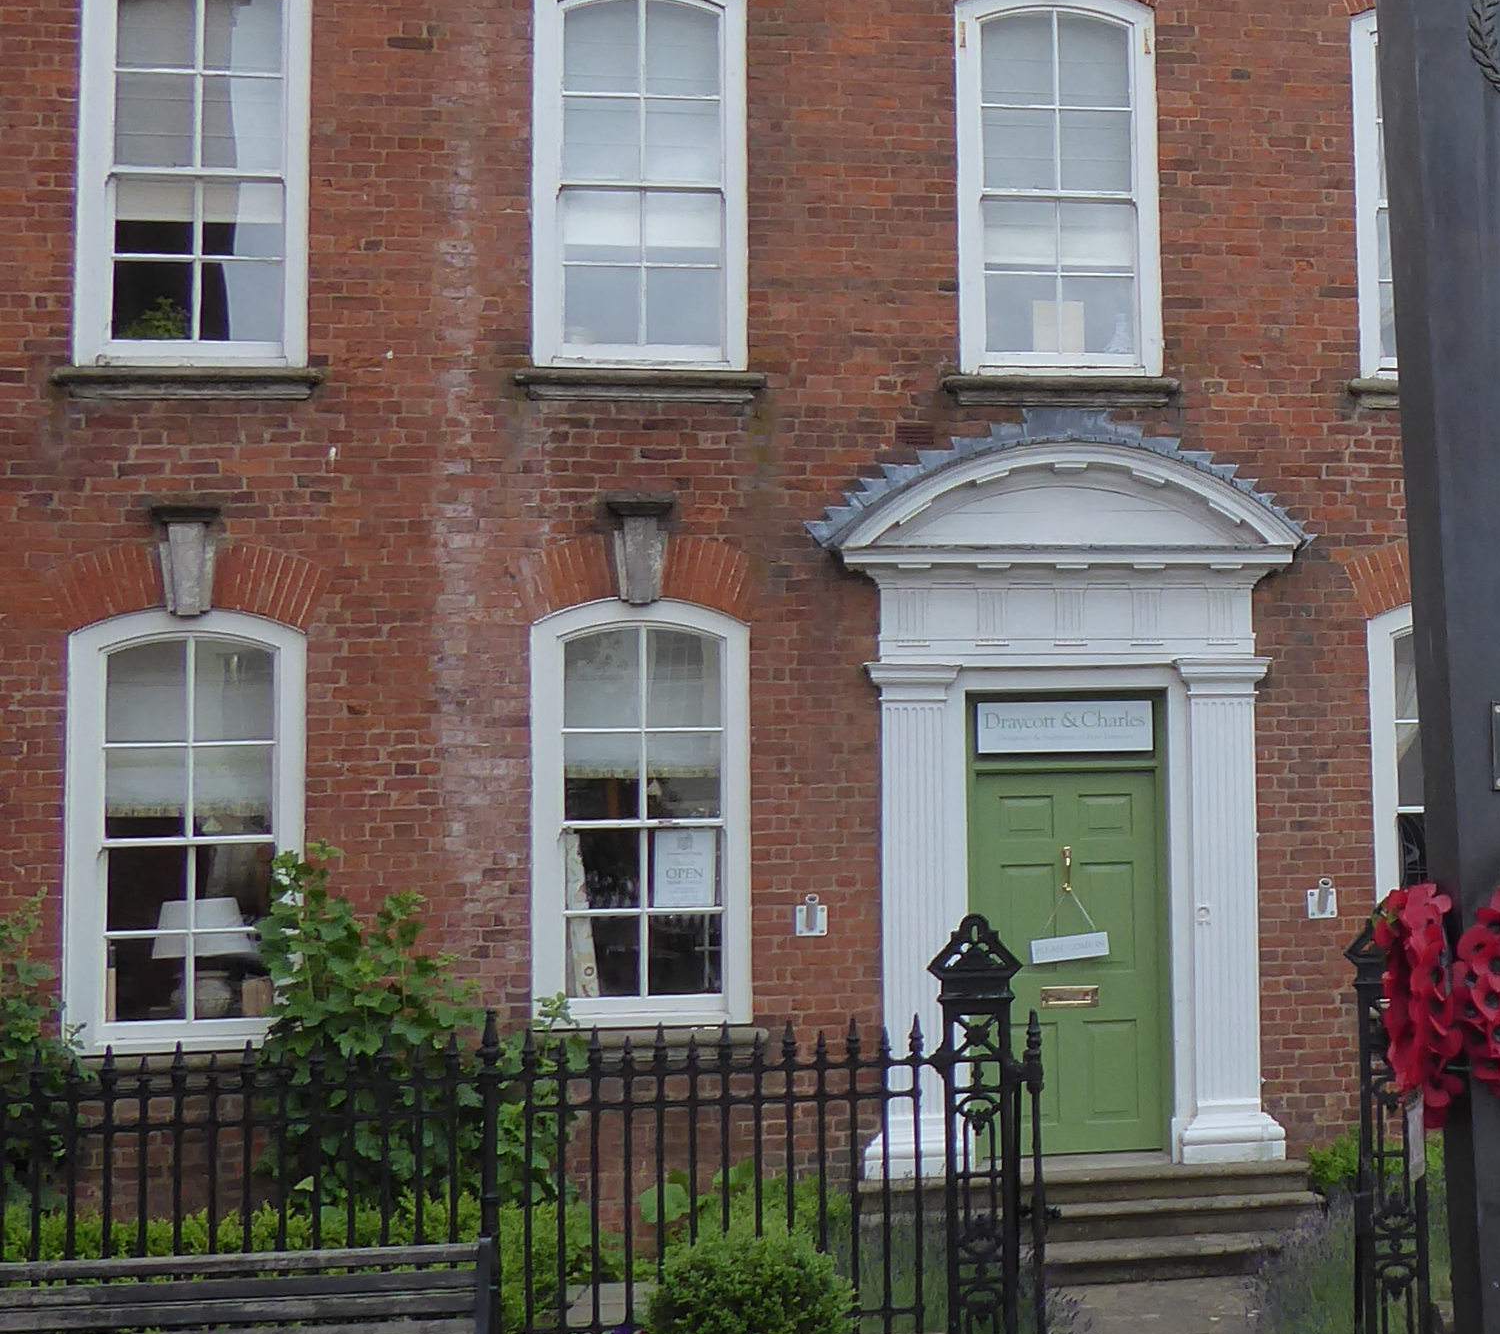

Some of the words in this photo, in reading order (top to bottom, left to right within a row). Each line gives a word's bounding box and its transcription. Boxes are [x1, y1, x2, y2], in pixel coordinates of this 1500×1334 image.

[983, 711, 1056, 732] Draycott
[1061, 710, 1079, 728] &
[1081, 708, 1146, 728] Charles
[665, 867, 704, 879] OPEN
